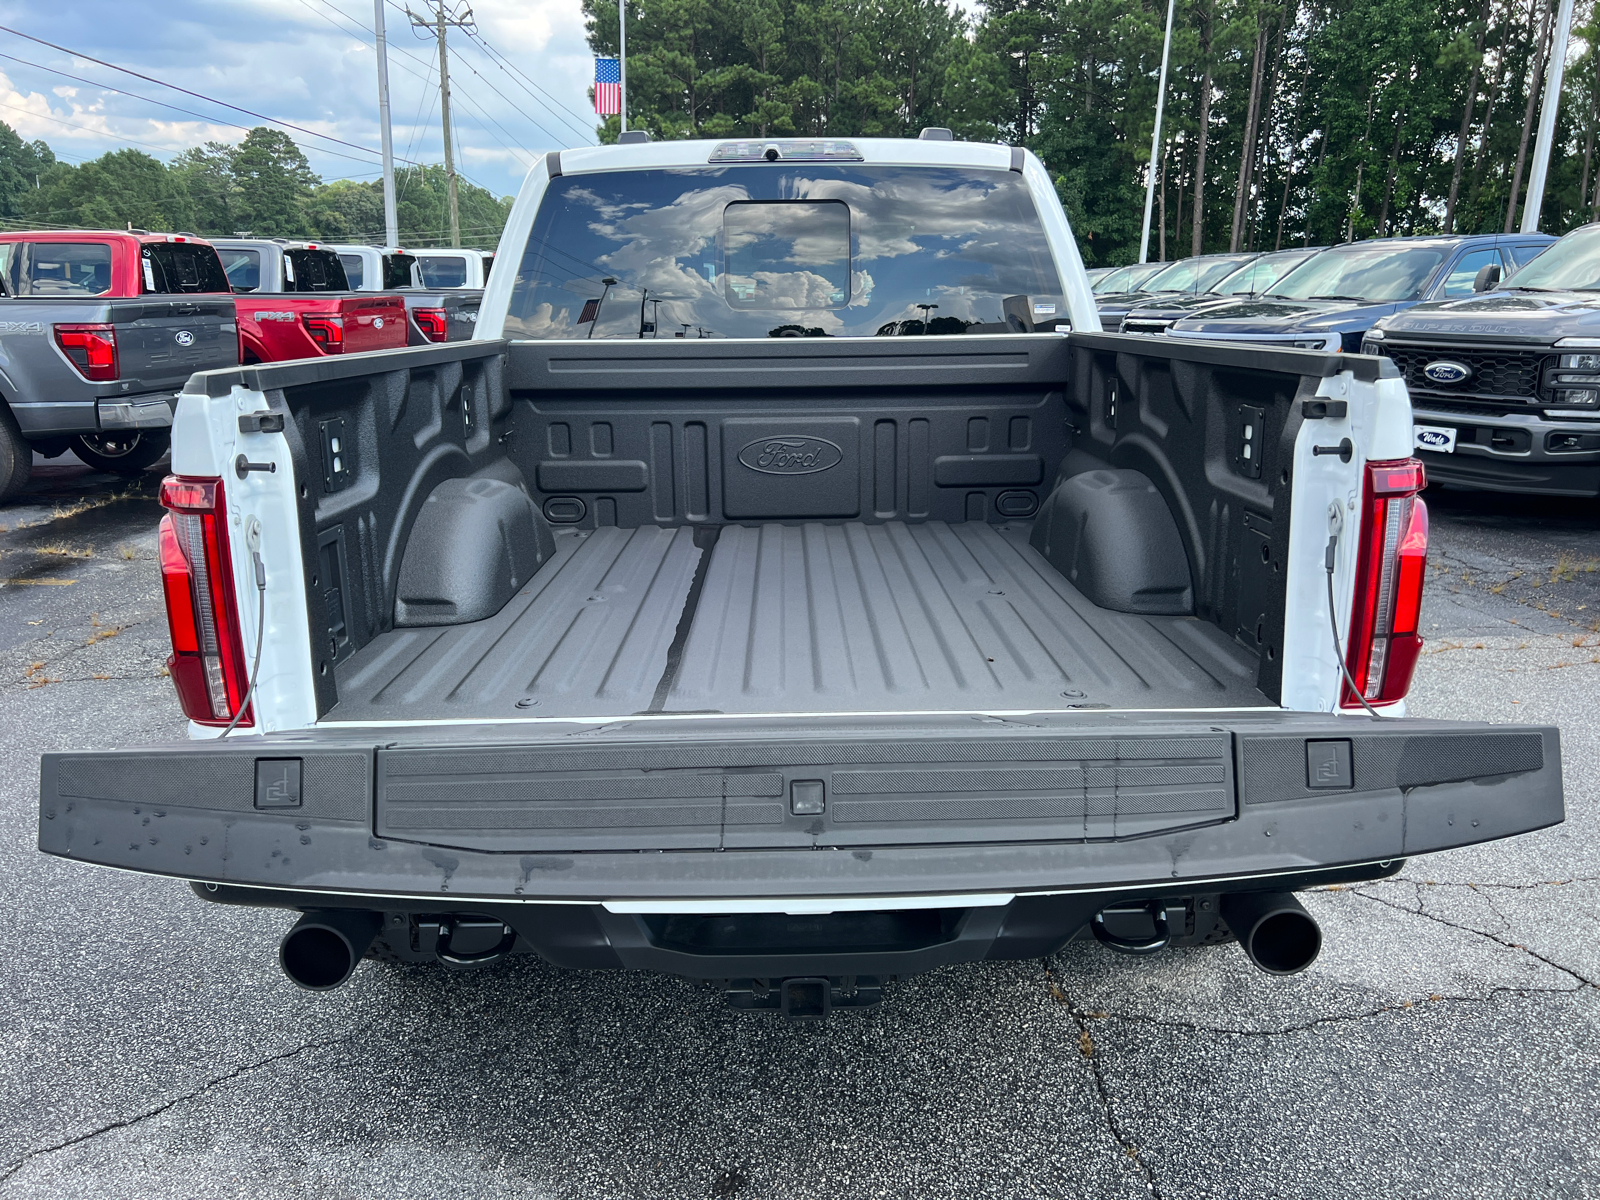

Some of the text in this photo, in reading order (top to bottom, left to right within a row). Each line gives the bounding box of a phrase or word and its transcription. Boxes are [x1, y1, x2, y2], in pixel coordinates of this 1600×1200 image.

[254, 311, 294, 322] FX4
[1402, 321, 1531, 334] SUPER DUTY
[1433, 366, 1456, 380] Ford
[1423, 432, 1445, 444] Wade
[757, 440, 821, 467] Ford
